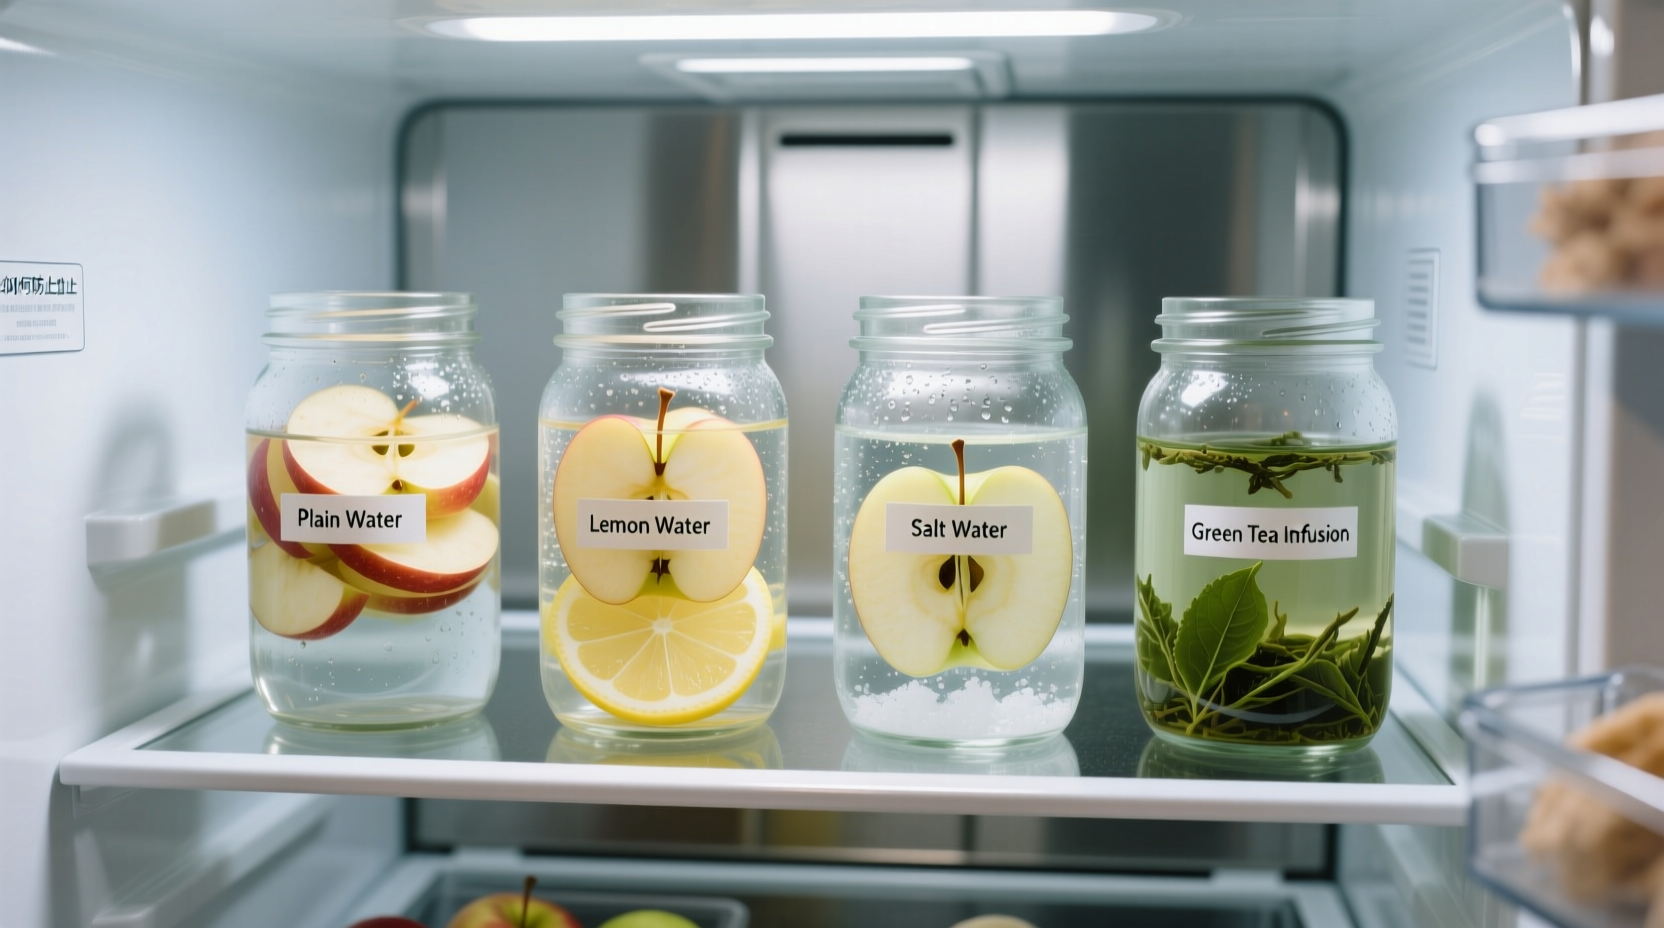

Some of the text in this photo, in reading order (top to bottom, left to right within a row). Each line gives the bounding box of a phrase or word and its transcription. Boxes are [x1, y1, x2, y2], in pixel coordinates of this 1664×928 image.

[297, 507, 404, 530] Plain Water
[589, 514, 712, 536] Lemon Water
[910, 517, 1008, 540] Salt Water
[1190, 521, 1351, 545] Green Tea Infusion
